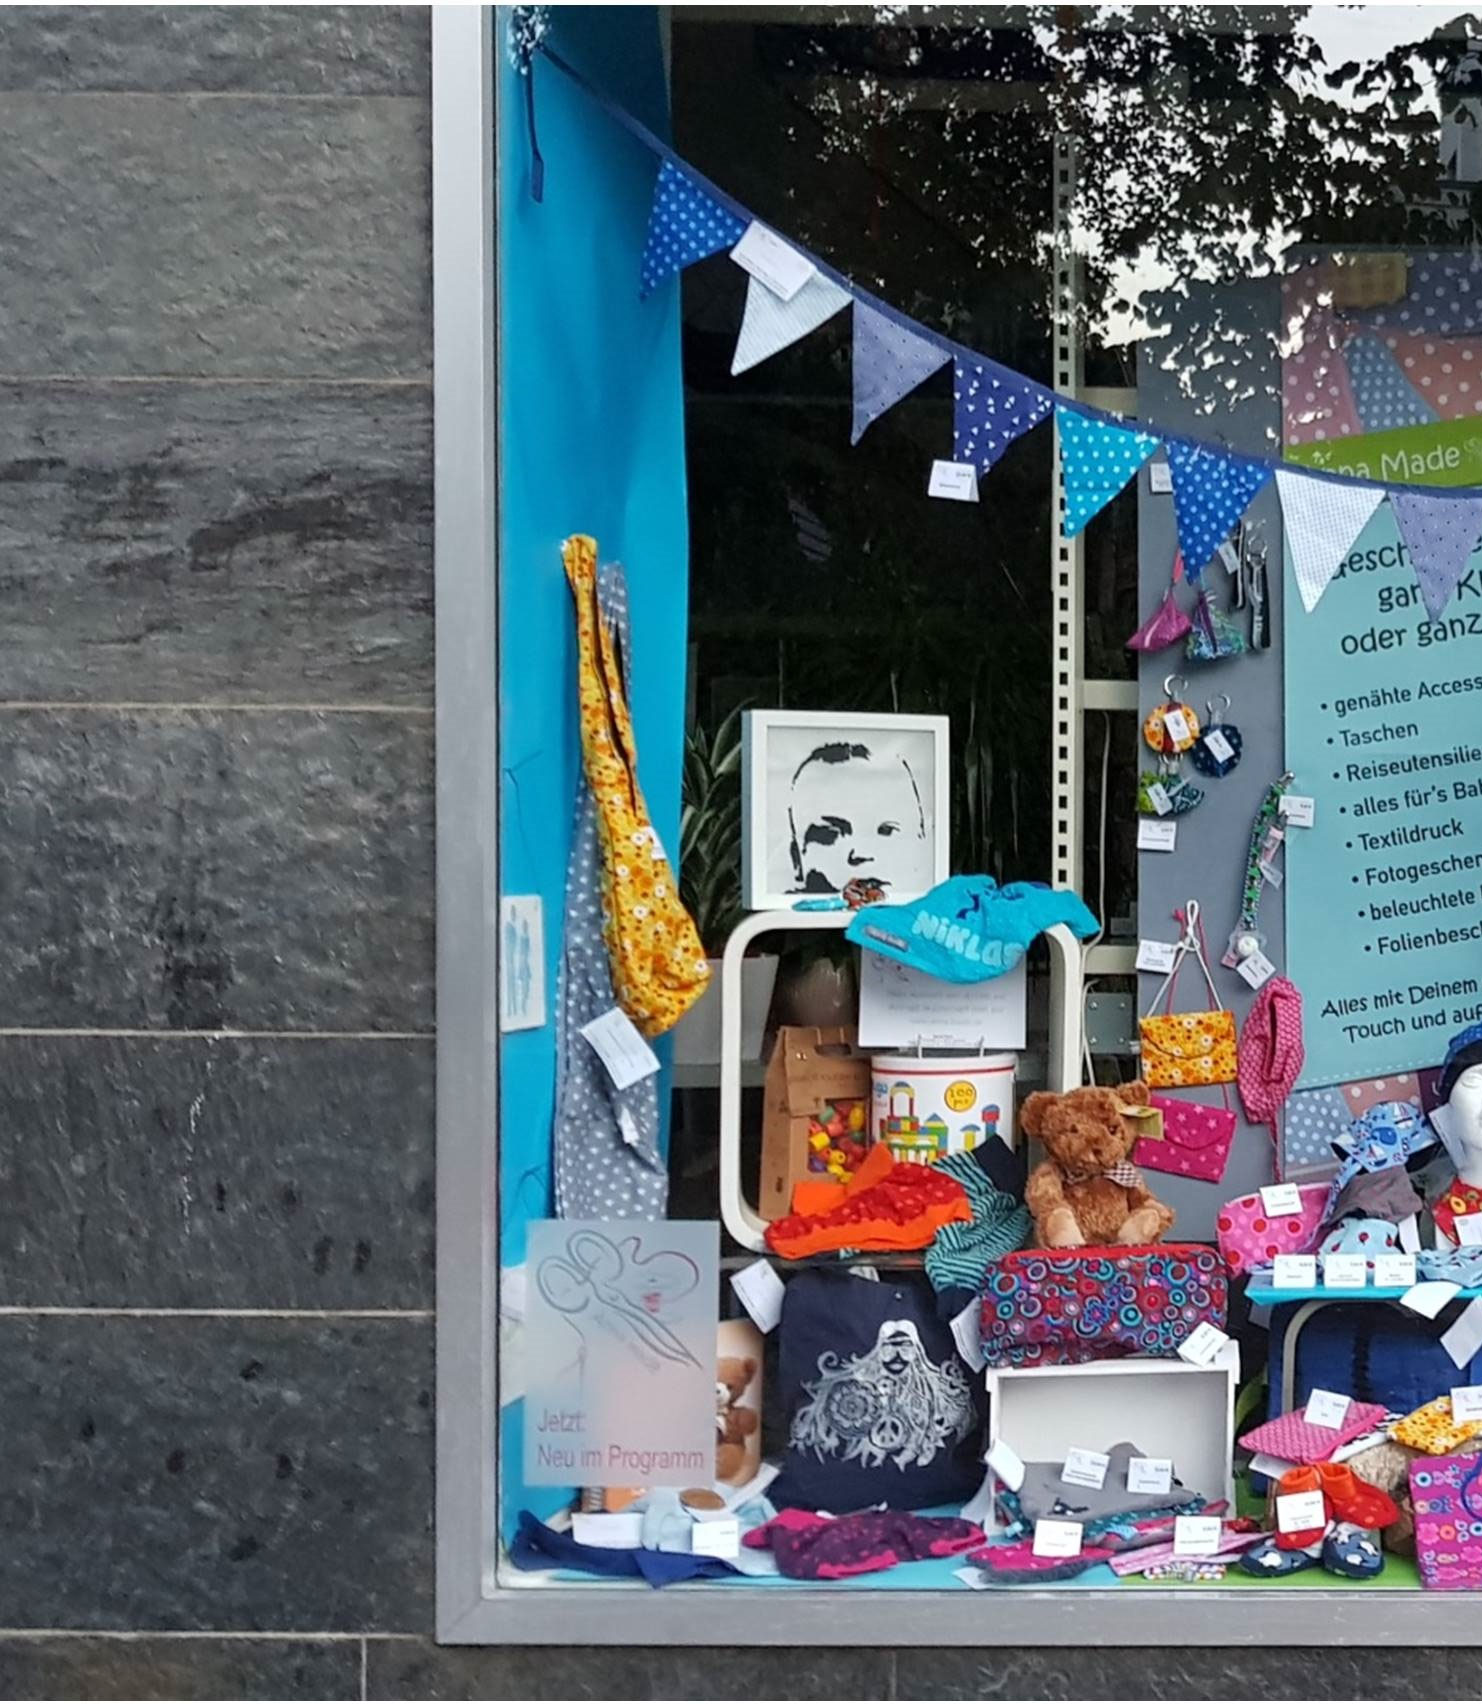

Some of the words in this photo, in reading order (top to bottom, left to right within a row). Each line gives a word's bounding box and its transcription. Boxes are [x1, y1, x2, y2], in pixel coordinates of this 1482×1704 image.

[1381, 445, 1460, 481] Made
[1341, 627, 1407, 654] oder
[1334, 687, 1412, 717] genähte
[1340, 721, 1419, 748] Taschen
[1352, 796, 1399, 818] alles
[1358, 818, 1464, 851] Textildruck
[1370, 888, 1476, 922] beleuchtete
[1321, 996, 1368, 1018] Alles
[1374, 989, 1404, 1009] mit
[1408, 978, 1478, 1005] Deinem
[1342, 1017, 1405, 1043] Touch
[1411, 1008, 1446, 1030] und
[537, 1443, 574, 1468] Neu
[581, 1443, 602, 1467] im
[608, 1444, 704, 1475] Programm
